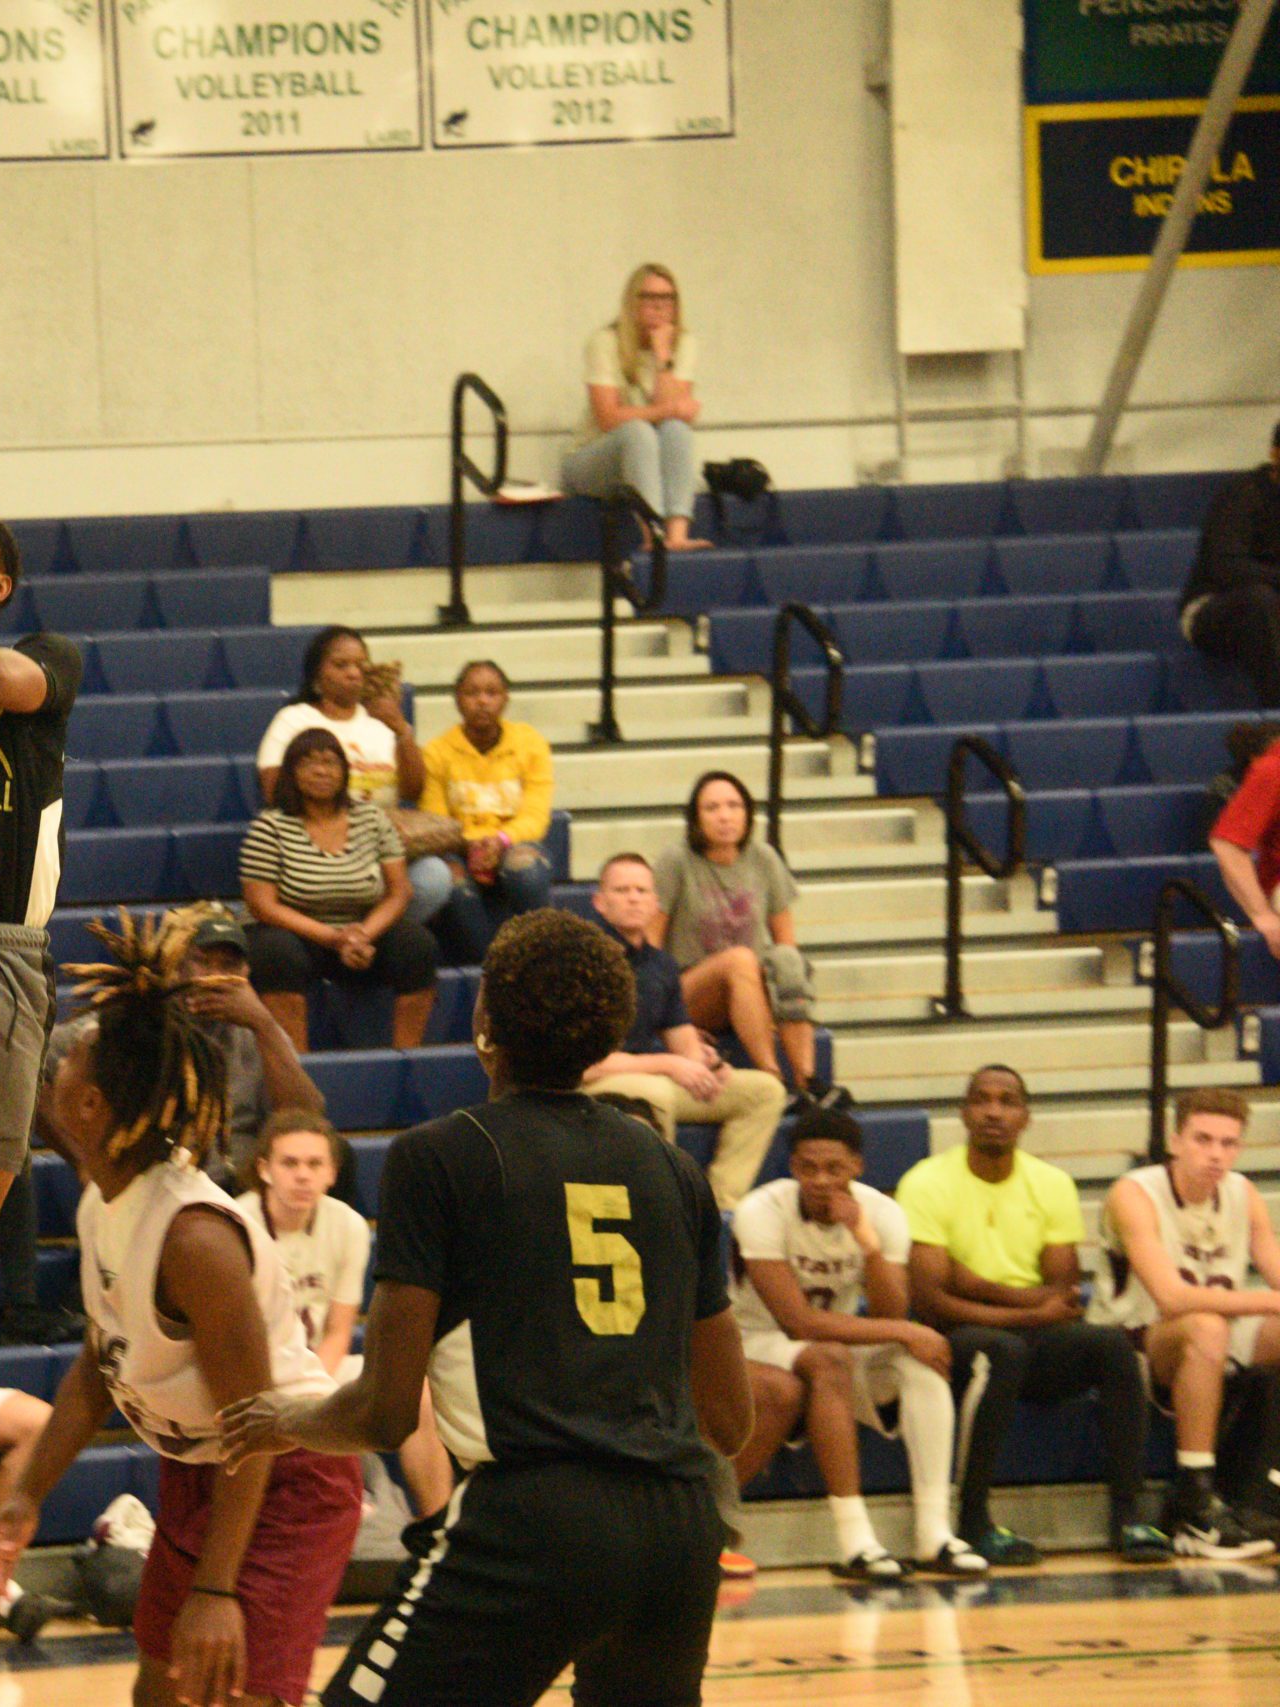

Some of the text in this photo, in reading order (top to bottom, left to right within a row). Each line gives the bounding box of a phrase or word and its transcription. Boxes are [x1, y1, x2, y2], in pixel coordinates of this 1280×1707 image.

[153, 20, 382, 59] CHAMPIONS
[467, 8, 693, 50] CHAMPIONS
[176, 69, 363, 99] VOLLEYBALL
[487, 58, 674, 89] VOLLEYBALL
[241, 110, 301, 136] 2011
[552, 98, 614, 125] 2012
[1109, 151, 1255, 187] CHIPLA
[1133, 189, 1232, 217] INDNS
[564, 1182, 646, 1335] 5
